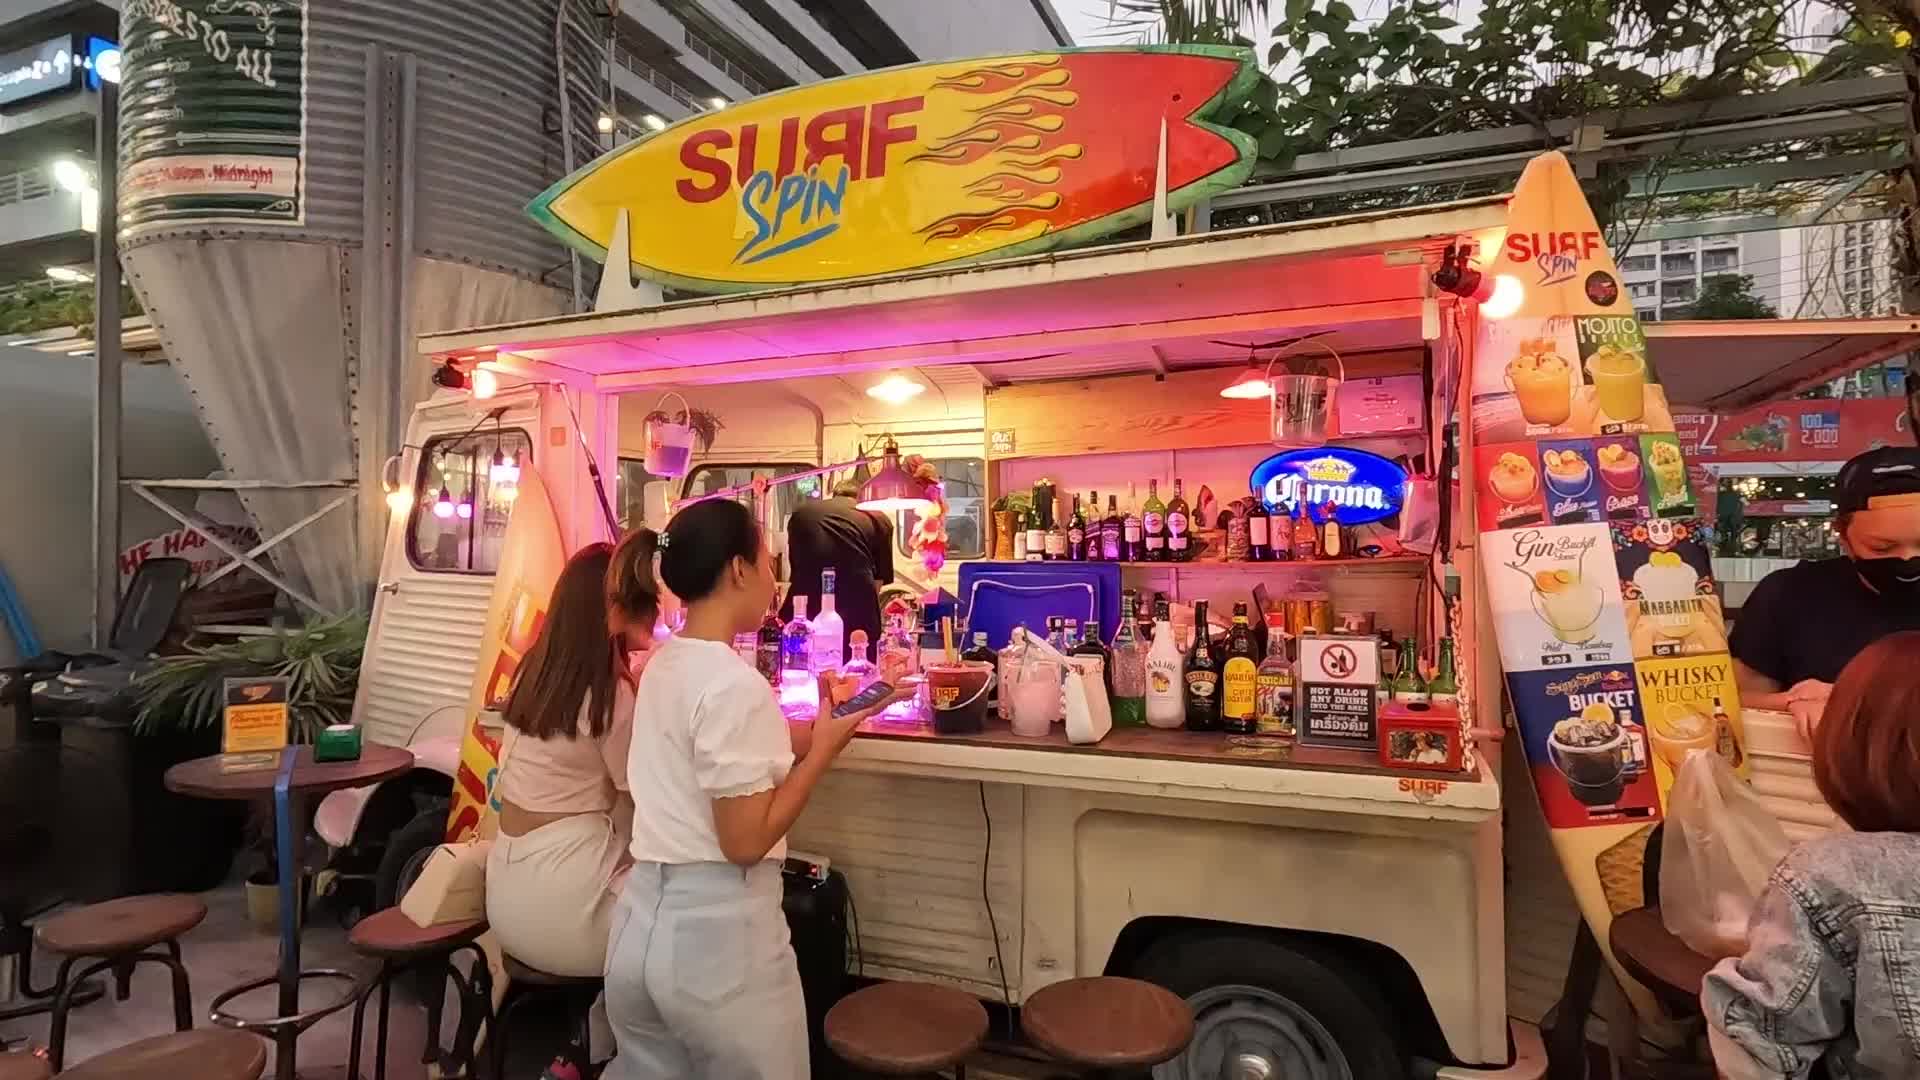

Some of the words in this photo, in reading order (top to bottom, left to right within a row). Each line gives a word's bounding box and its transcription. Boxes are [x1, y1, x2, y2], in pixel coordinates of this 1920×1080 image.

[676, 96, 925, 204] SURF
[212, 164, 273, 190] Midnight
[1506, 232, 1599, 263] SURF
[1577, 317, 1637, 336] MOJITO
[1512, 530, 1555, 567] Gin
[1639, 599, 1704, 616] MARGARITA
[1641, 664, 1728, 688] WHISKY
[1310, 687, 1330, 696] NOT
[1333, 688, 1368, 697] ALLOW
[1334, 696, 1368, 705] DRINK
[1569, 690, 1634, 712] BUCKET
[1656, 683, 1727, 704] BUCKET
